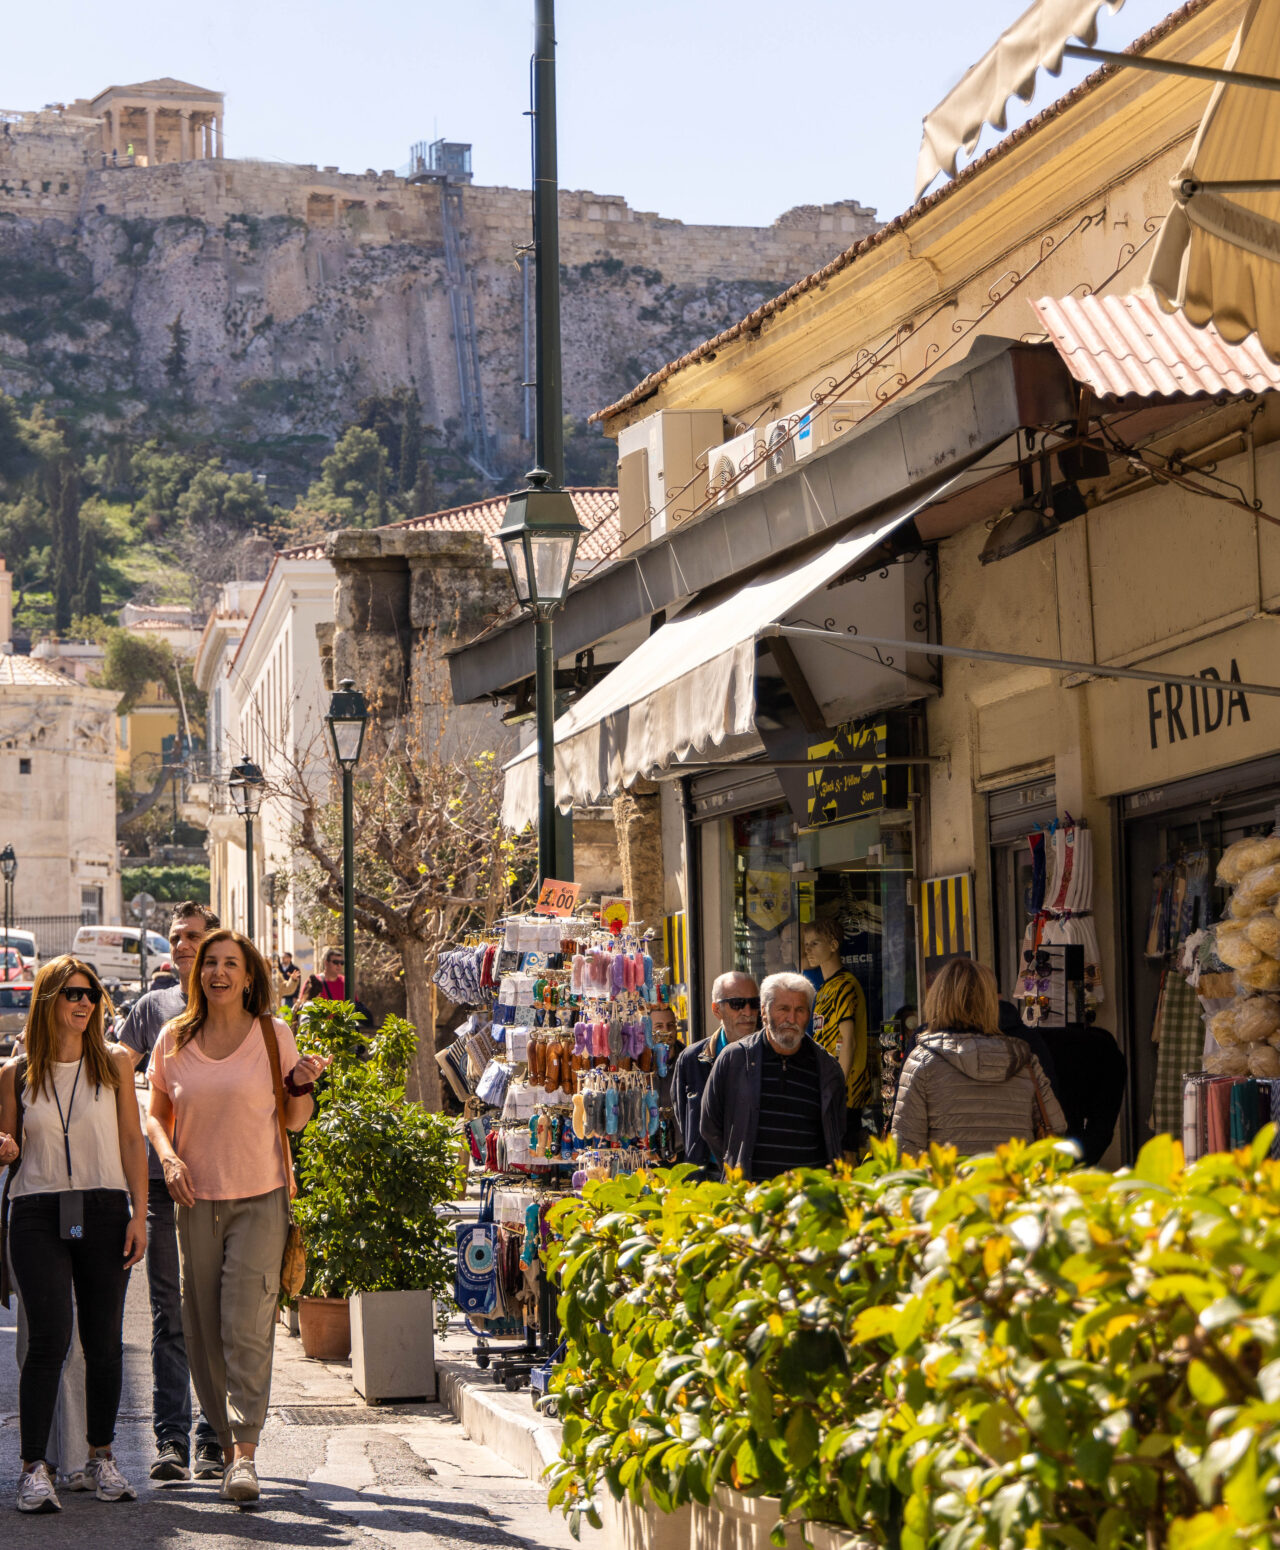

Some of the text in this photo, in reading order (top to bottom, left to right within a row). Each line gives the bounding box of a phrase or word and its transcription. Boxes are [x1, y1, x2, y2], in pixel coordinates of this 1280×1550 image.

[1147, 658, 1251, 750] FRIDA
[540, 888, 574, 910] 1.00
[840, 954, 873, 965] REECE
